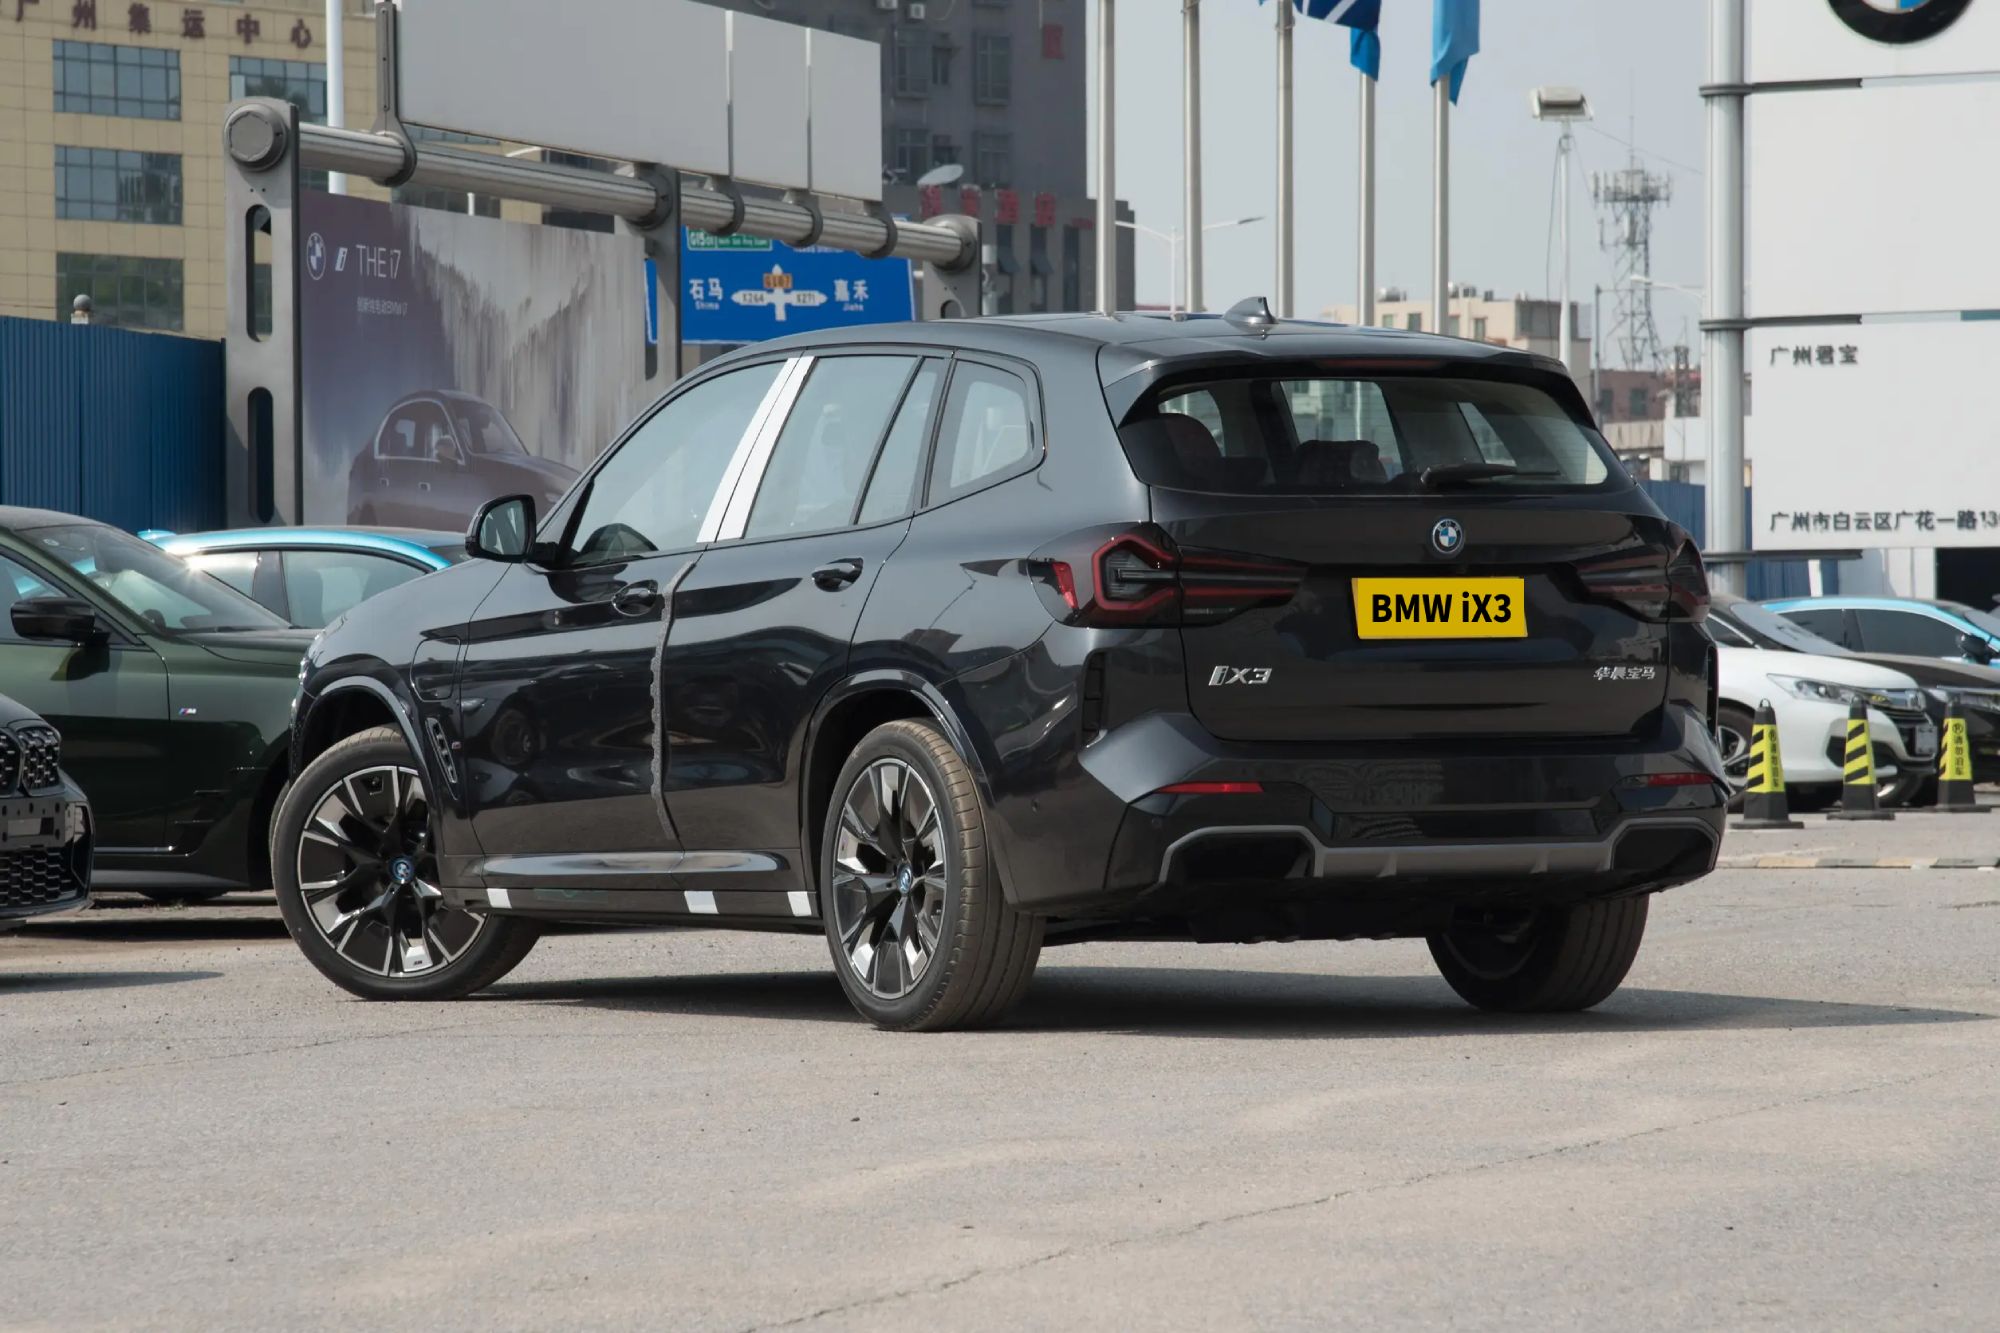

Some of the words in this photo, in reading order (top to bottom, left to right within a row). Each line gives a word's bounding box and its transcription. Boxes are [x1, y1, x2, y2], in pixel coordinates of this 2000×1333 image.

[356, 244, 387, 277] THE
[689, 278, 723, 300] 石马
[1593, 666, 1656, 681] 华晨宝马
